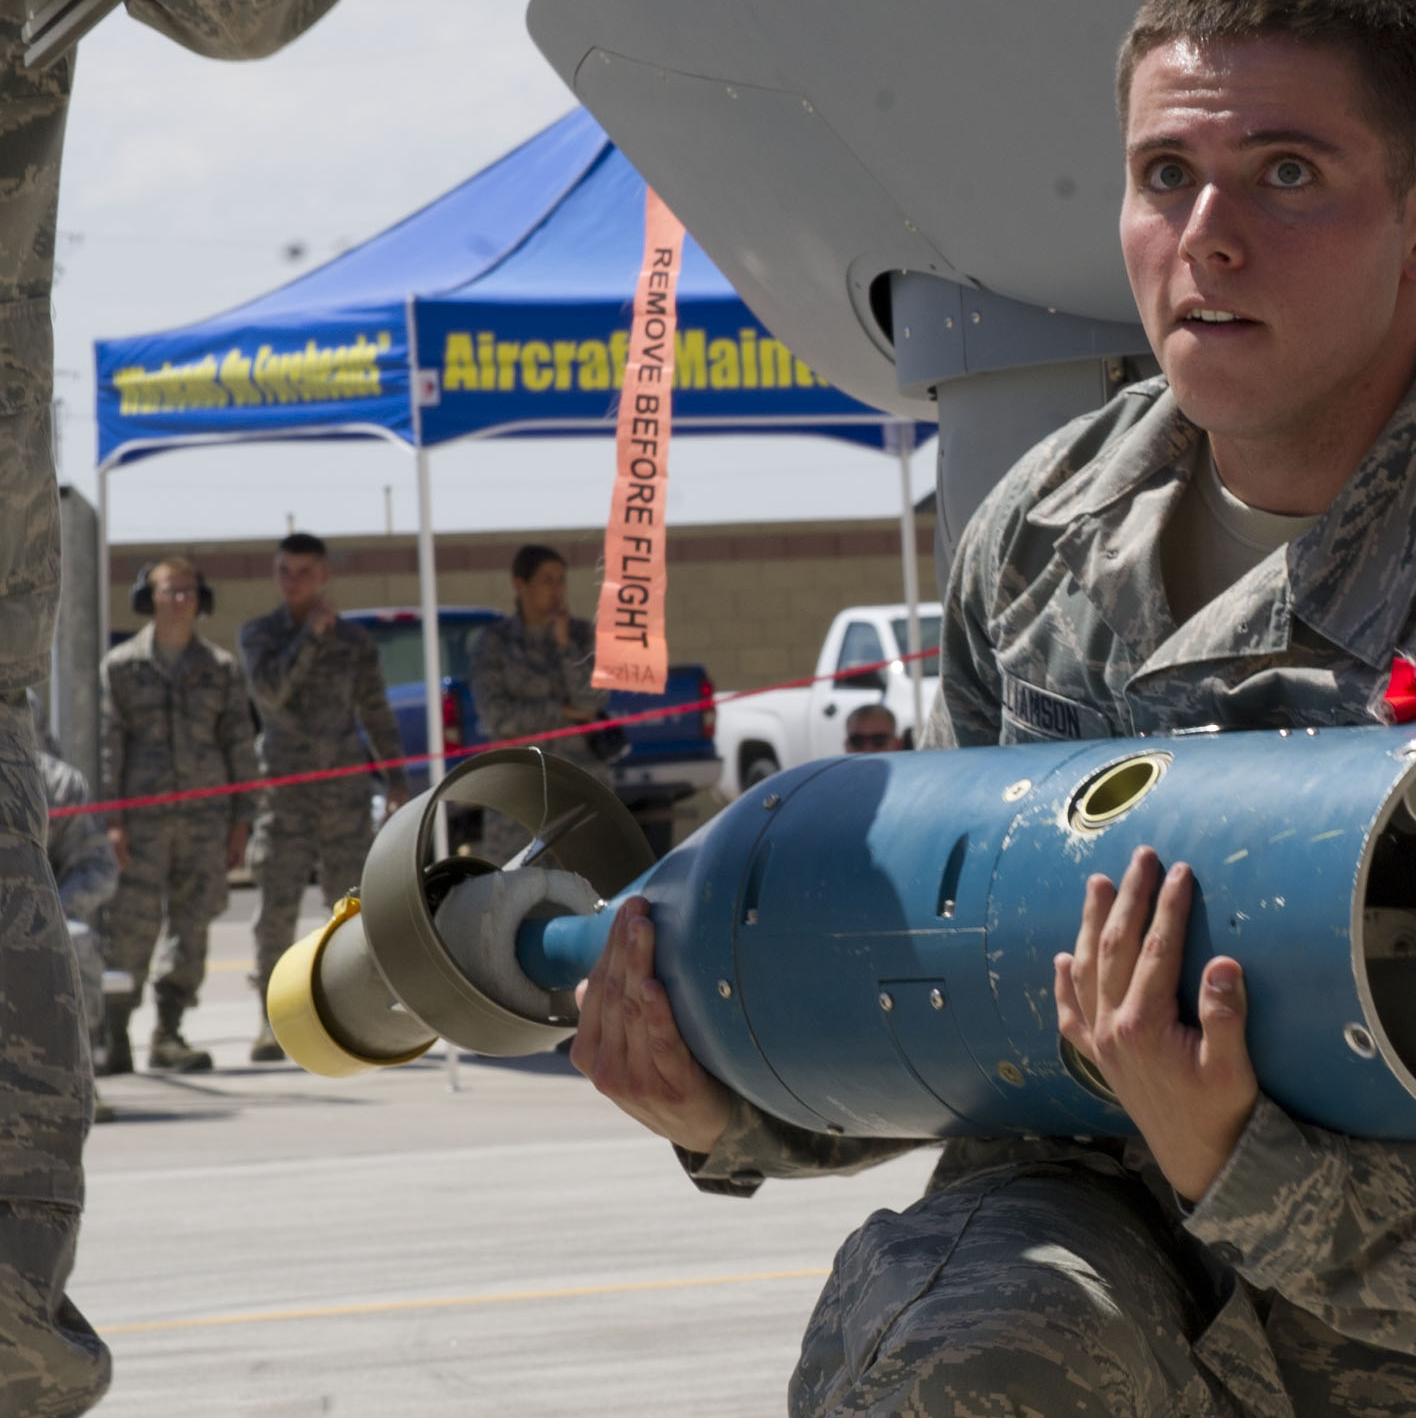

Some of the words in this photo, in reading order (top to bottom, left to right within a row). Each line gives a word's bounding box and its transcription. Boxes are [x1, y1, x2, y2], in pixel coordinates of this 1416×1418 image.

[443, 331, 632, 392] Aircraf
[672, 327, 831, 390] Main
[638, 247, 673, 384] REMOVE
[624, 394, 660, 526] BEFORE
[614, 534, 652, 649] FLIGHT
